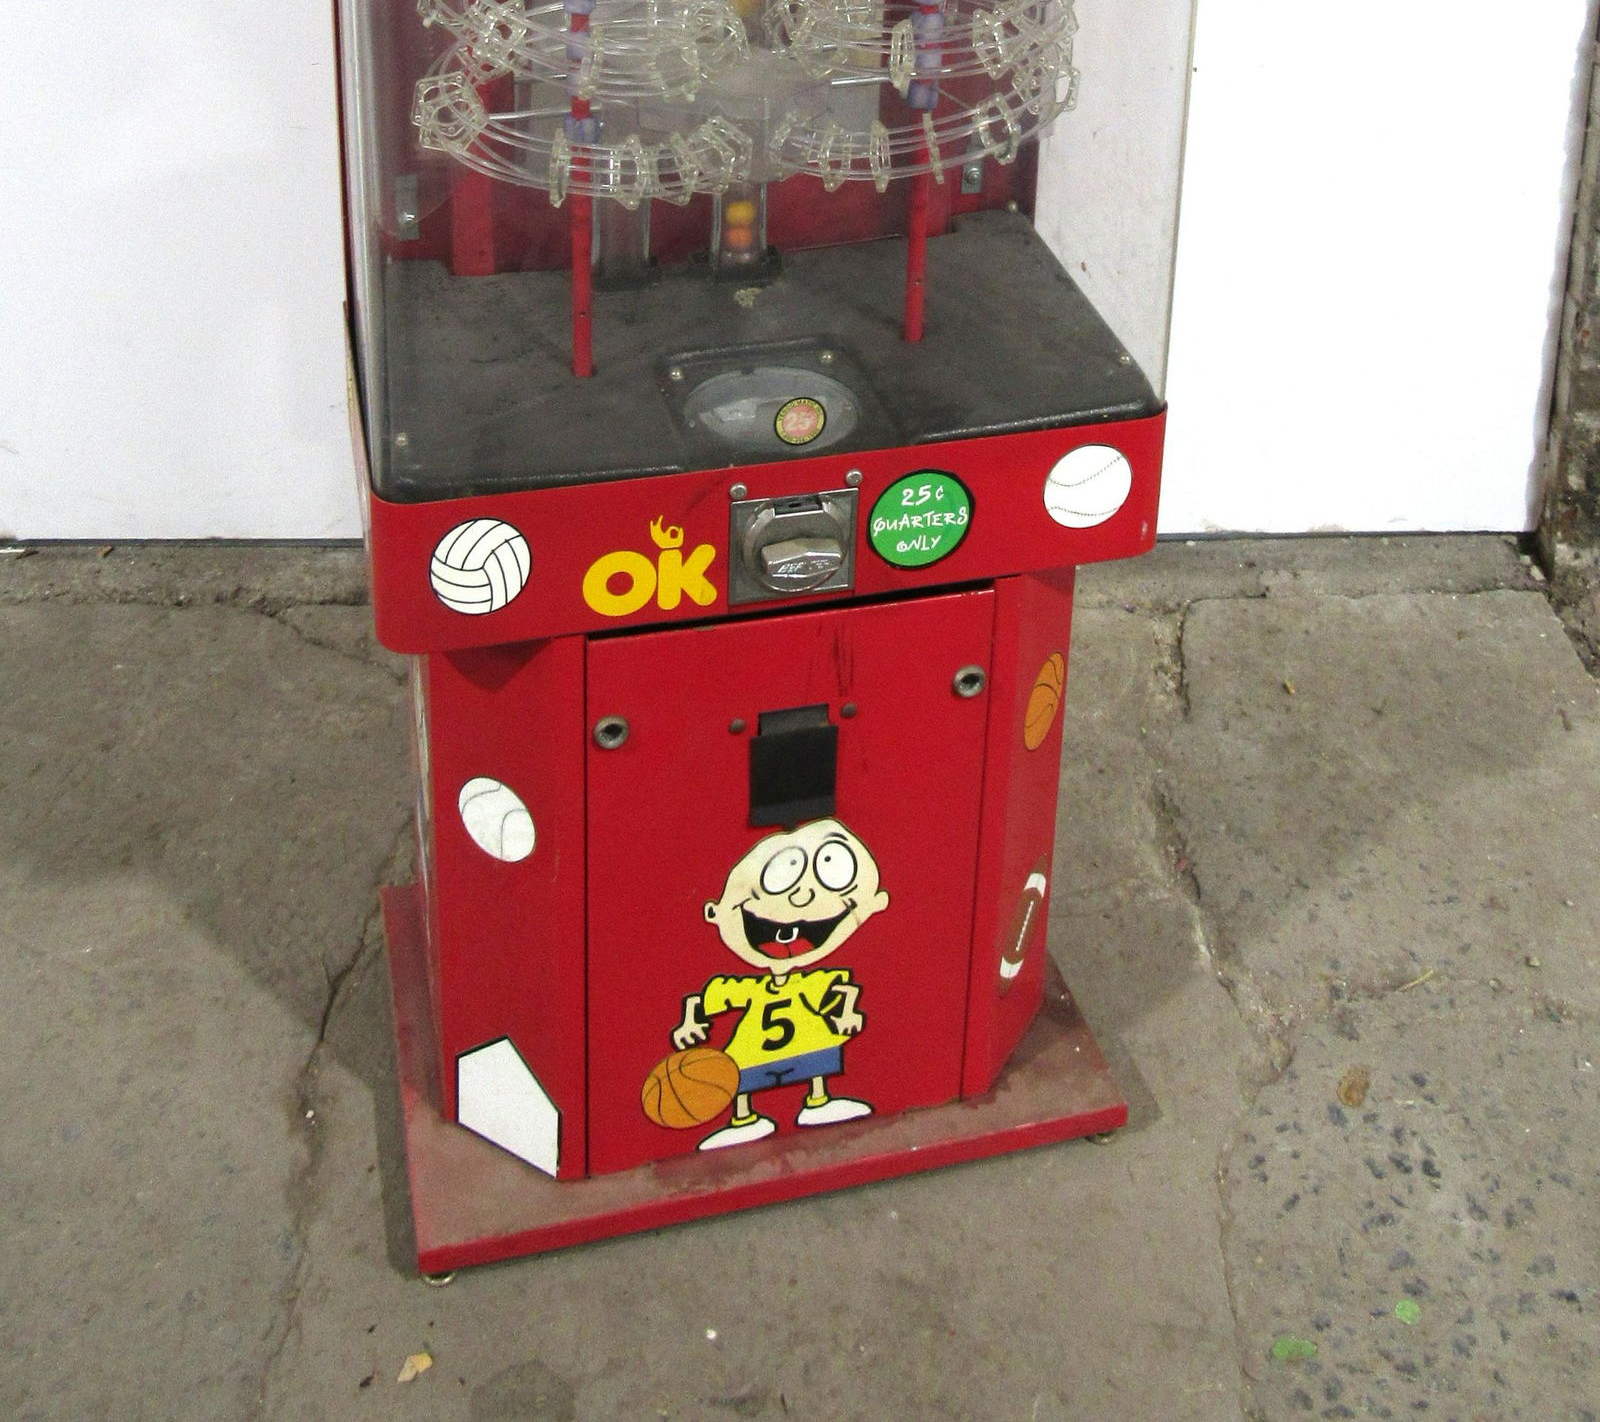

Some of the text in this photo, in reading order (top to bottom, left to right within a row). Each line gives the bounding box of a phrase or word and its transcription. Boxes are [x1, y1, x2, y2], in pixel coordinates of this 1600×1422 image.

[873, 506, 968, 537] QUARTERS
[896, 535, 942, 552] ONLY
[583, 543, 717, 616] OK
[761, 999, 795, 1051] 5
